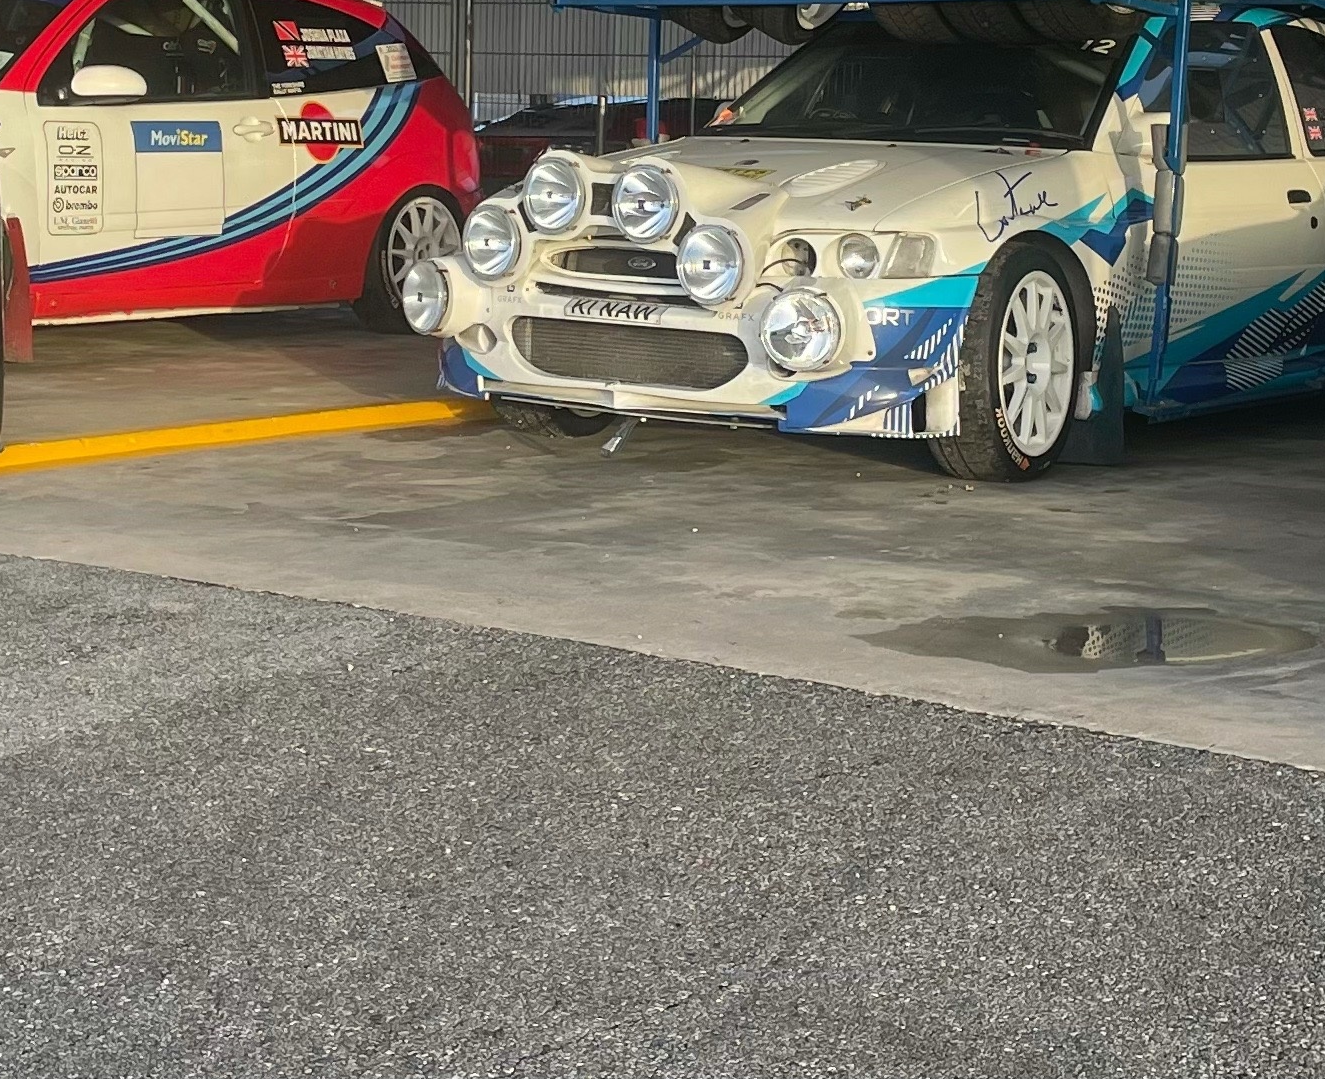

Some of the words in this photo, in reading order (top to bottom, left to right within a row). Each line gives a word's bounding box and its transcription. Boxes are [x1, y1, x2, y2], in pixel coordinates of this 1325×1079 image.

[1080, 39, 1116, 54] 12
[150, 128, 209, 146] MoviStar
[281, 121, 358, 142] MARTINI
[54, 166, 97, 178] sparco
[54, 185, 98, 194] AUTOCAR
[66, 200, 98, 210] brembo
[600, 302, 658, 320] NAW
[718, 311, 755, 321] GRAFX
[865, 307, 914, 326] ORT
